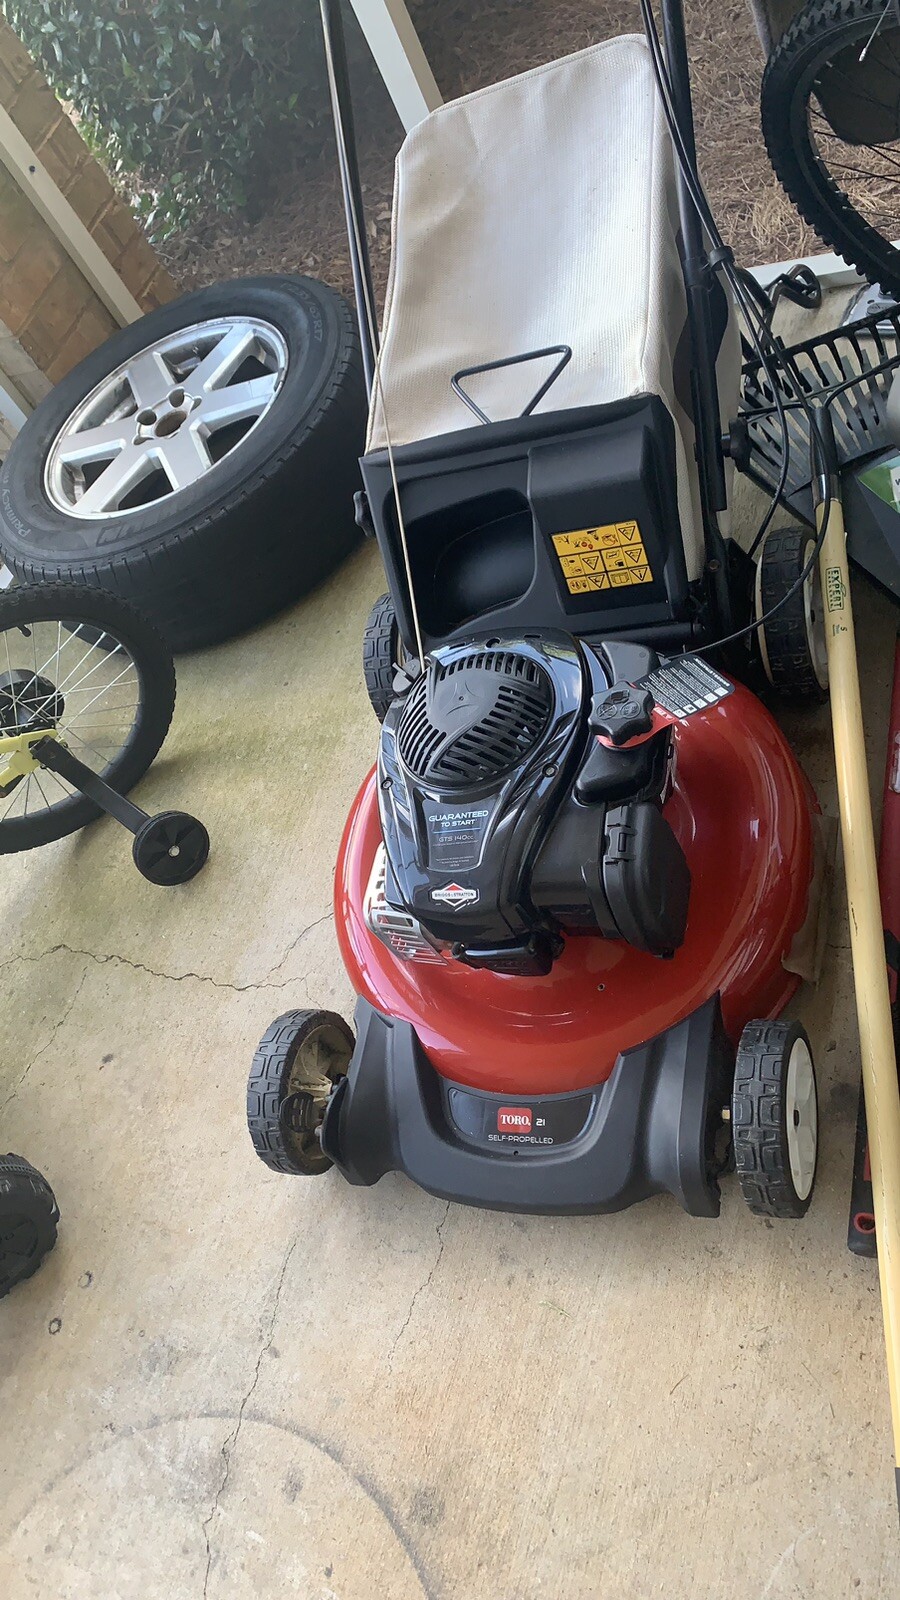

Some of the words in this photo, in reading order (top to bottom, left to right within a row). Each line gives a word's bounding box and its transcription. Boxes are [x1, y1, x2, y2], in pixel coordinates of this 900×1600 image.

[831, 569, 842, 607] EXPERT
[428, 810, 489, 822] GUARANTEED
[452, 819, 476, 827] START
[536, 1118, 546, 1126] 21
[488, 1134, 554, 1144] SELF-PROPELLED
